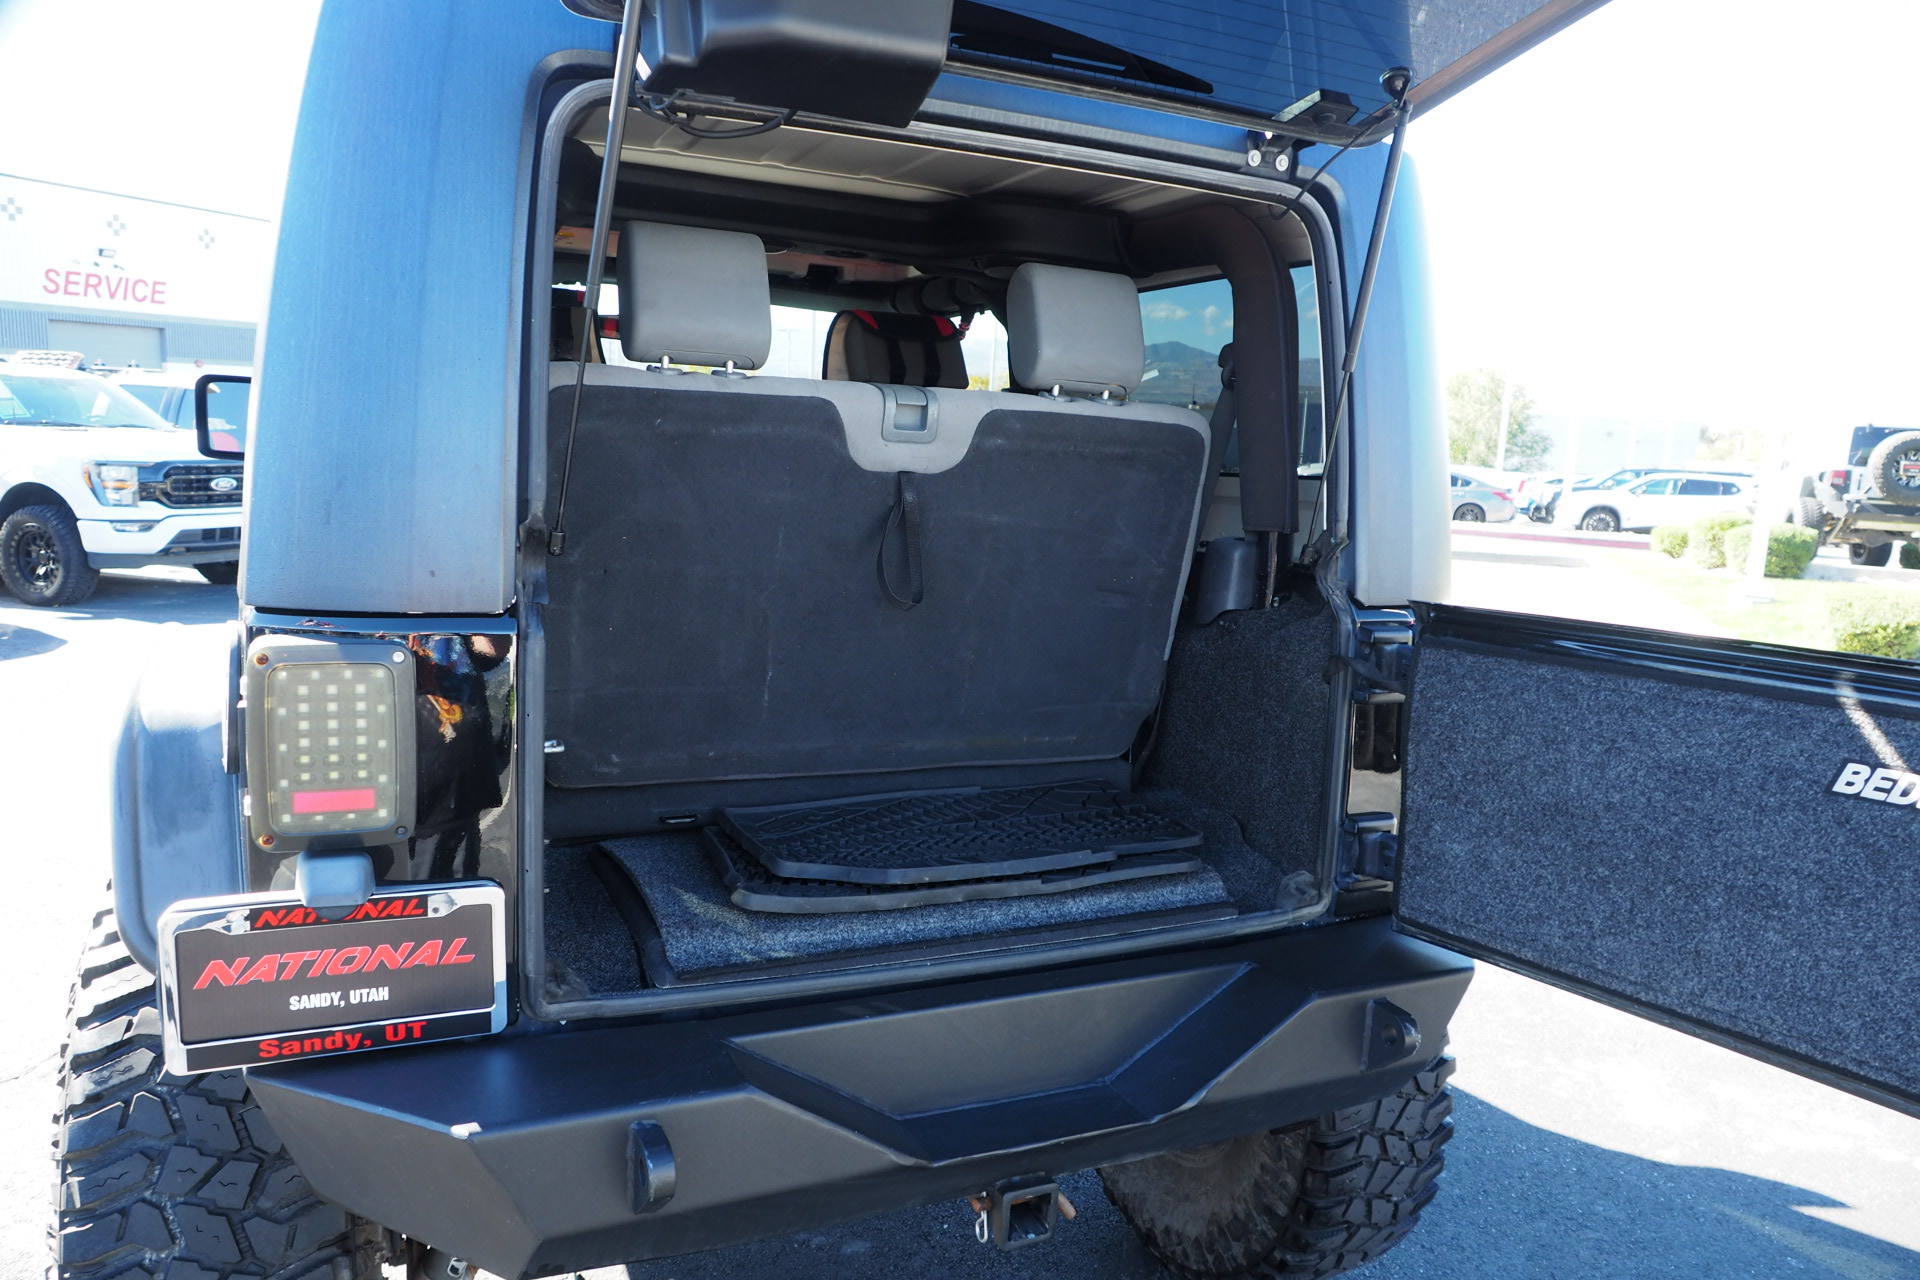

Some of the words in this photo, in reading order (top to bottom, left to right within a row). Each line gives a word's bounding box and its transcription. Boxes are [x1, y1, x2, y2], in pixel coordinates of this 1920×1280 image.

[42, 268, 167, 304] SERVICE
[1832, 762, 1920, 809] BED
[254, 898, 425, 928] NATNAL
[193, 937, 476, 990] NATIONAL
[289, 990, 345, 1011] SANDY,
[349, 986, 389, 1004] UTAH
[259, 1031, 372, 1058] Sandy,
[385, 1021, 427, 1042] UT
